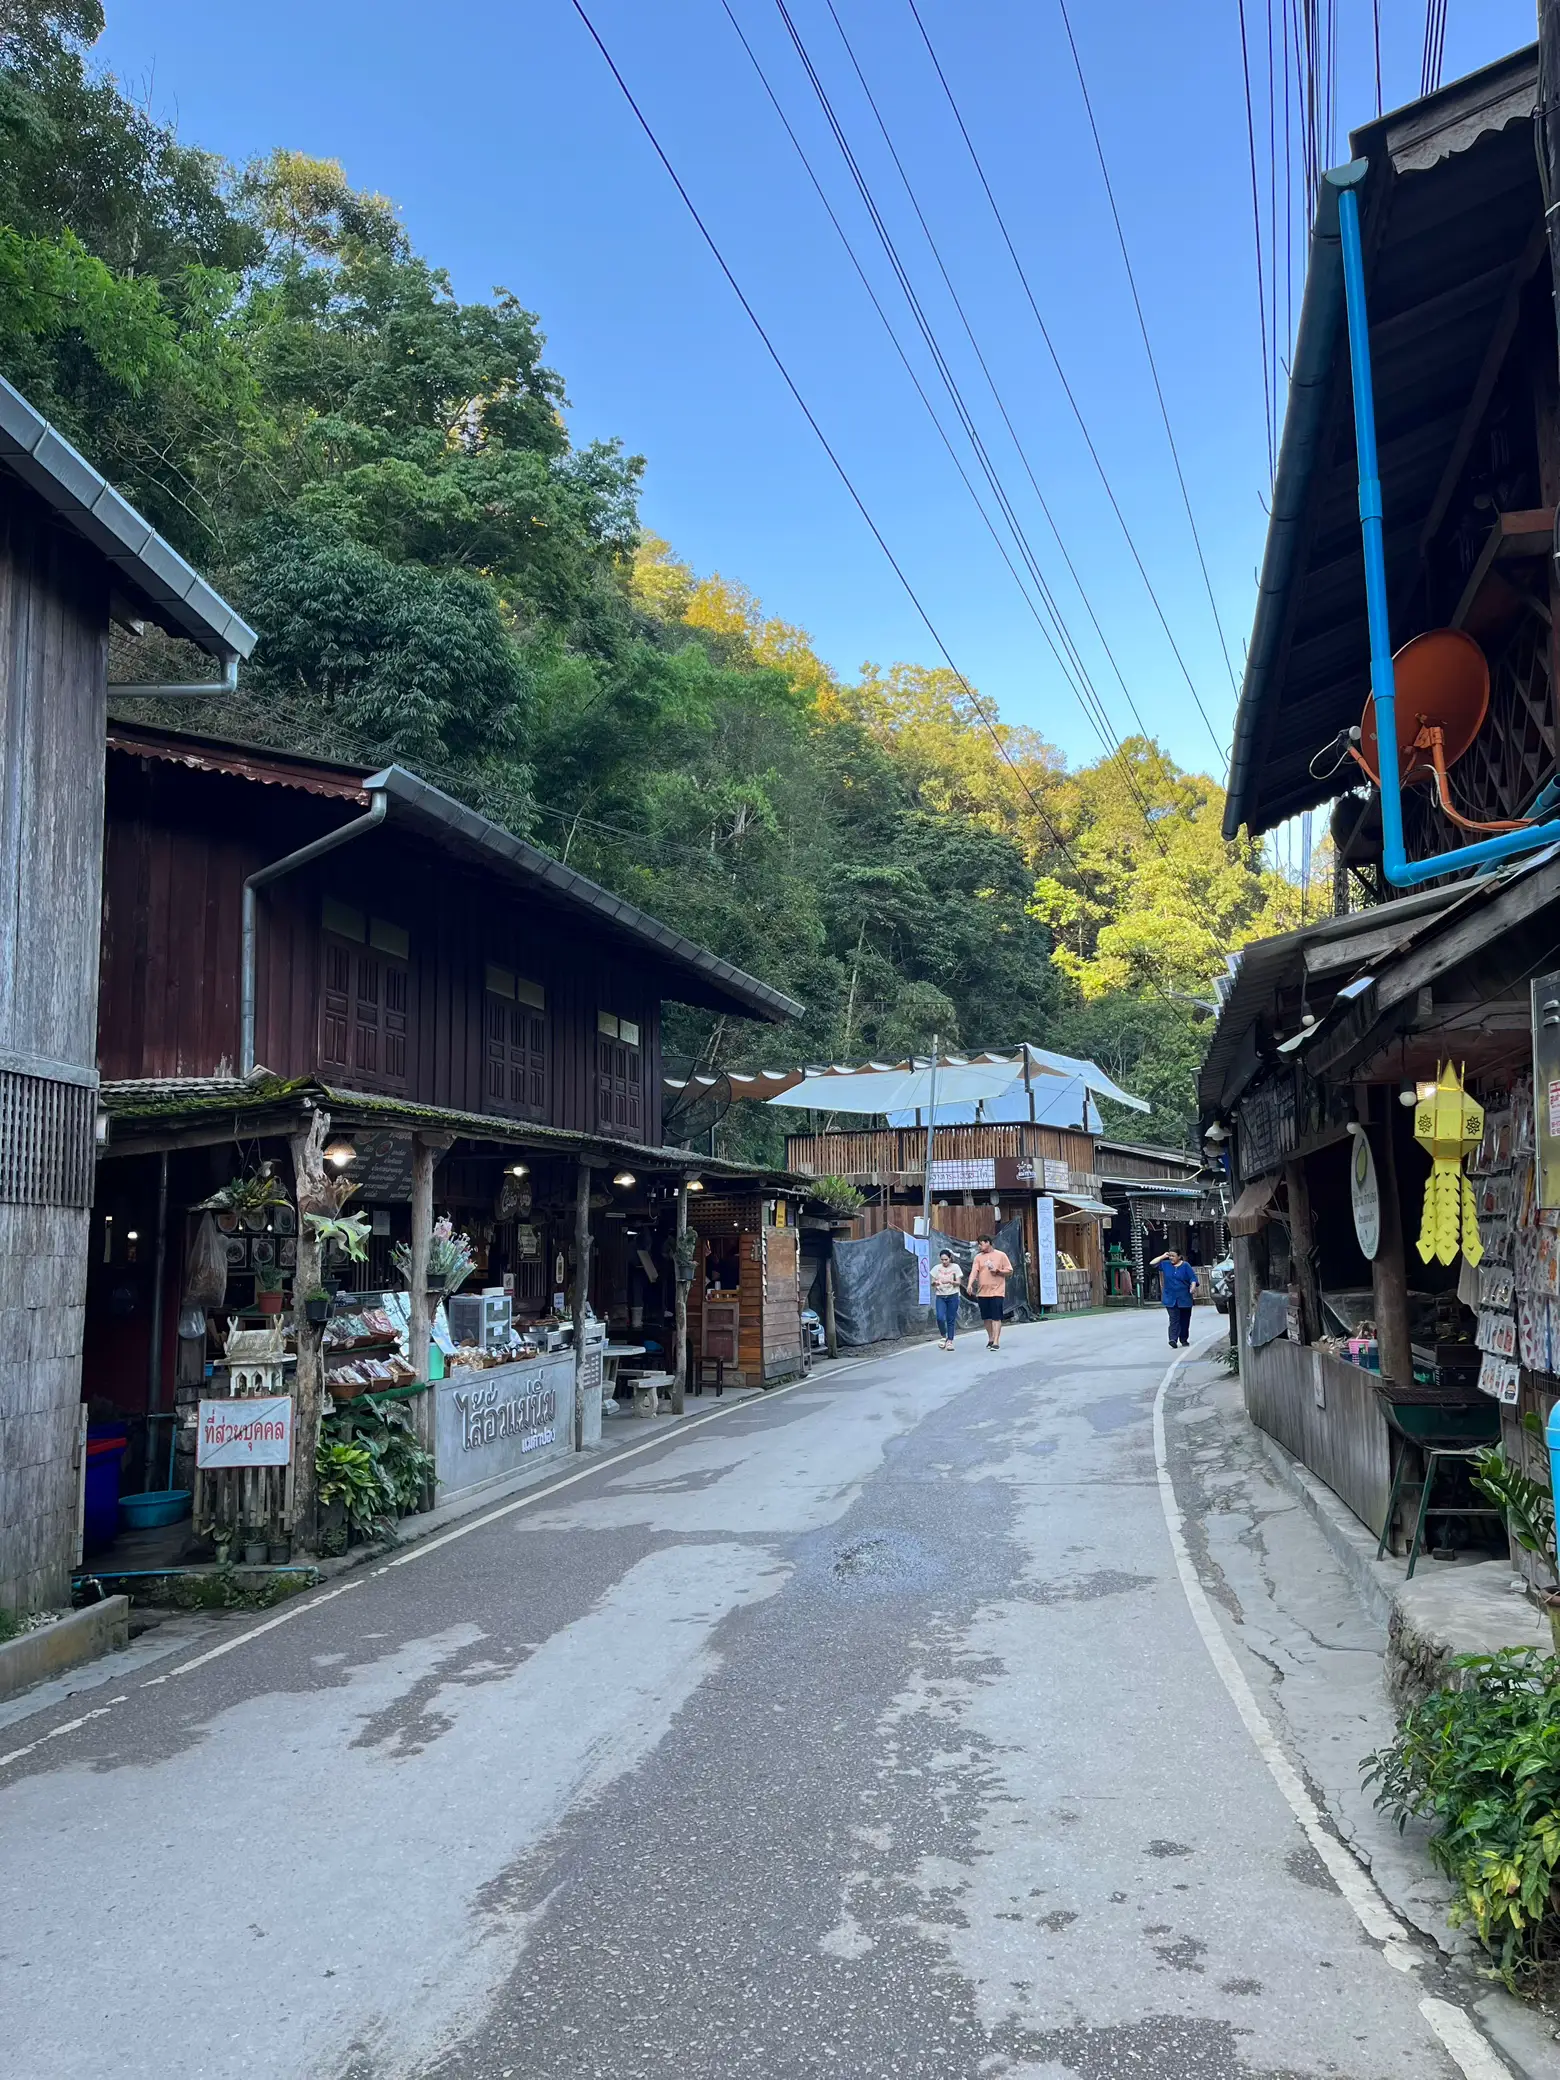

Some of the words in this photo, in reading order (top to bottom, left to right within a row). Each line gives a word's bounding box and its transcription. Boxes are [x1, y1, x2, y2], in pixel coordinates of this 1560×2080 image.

[204, 1408, 284, 1452] ที่ส่วนบุคคล
[521, 1427, 556, 1453] แม่กำปอง
